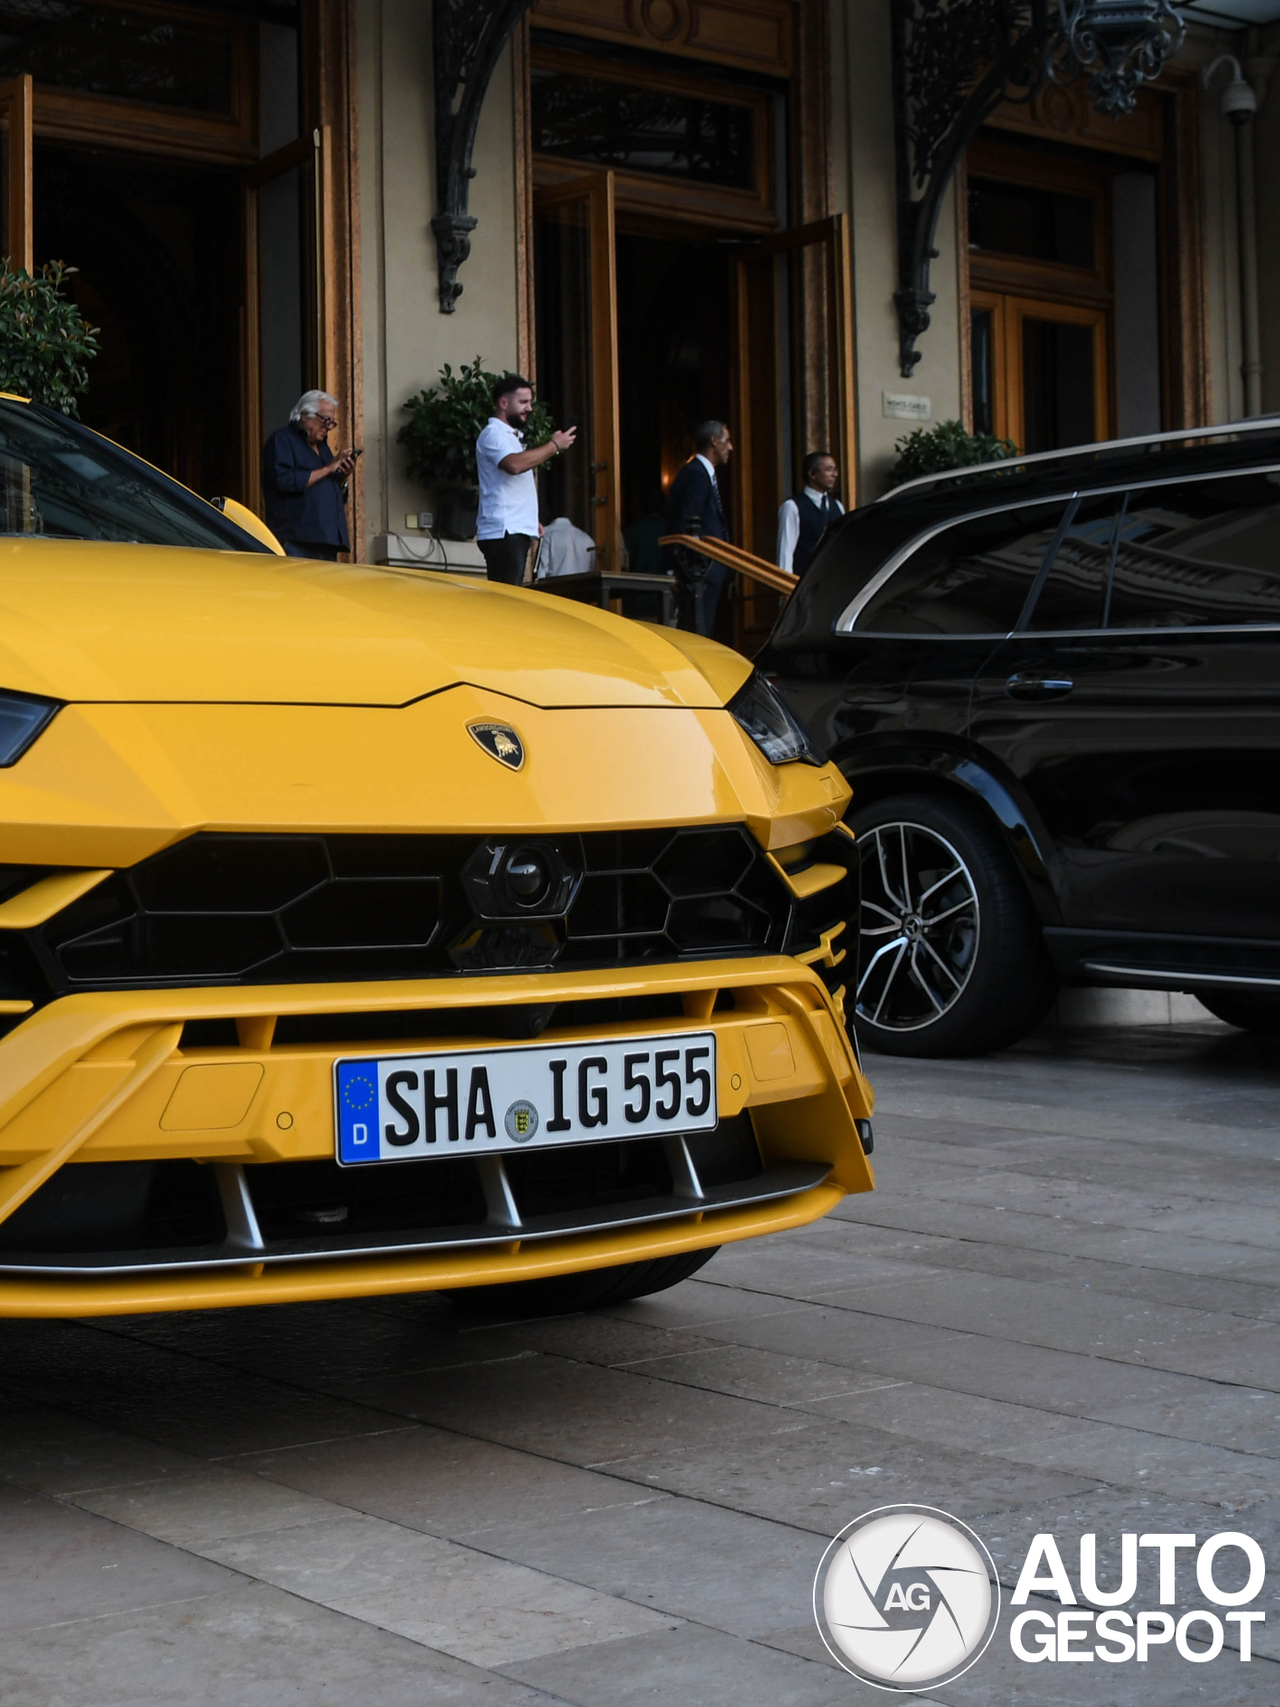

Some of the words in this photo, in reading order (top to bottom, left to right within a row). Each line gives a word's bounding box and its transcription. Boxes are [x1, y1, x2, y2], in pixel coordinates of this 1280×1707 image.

[384, 1065, 497, 1146] SHA
[546, 1056, 608, 1132] IG
[623, 1047, 711, 1123] 555
[352, 1123, 368, 1146] D
